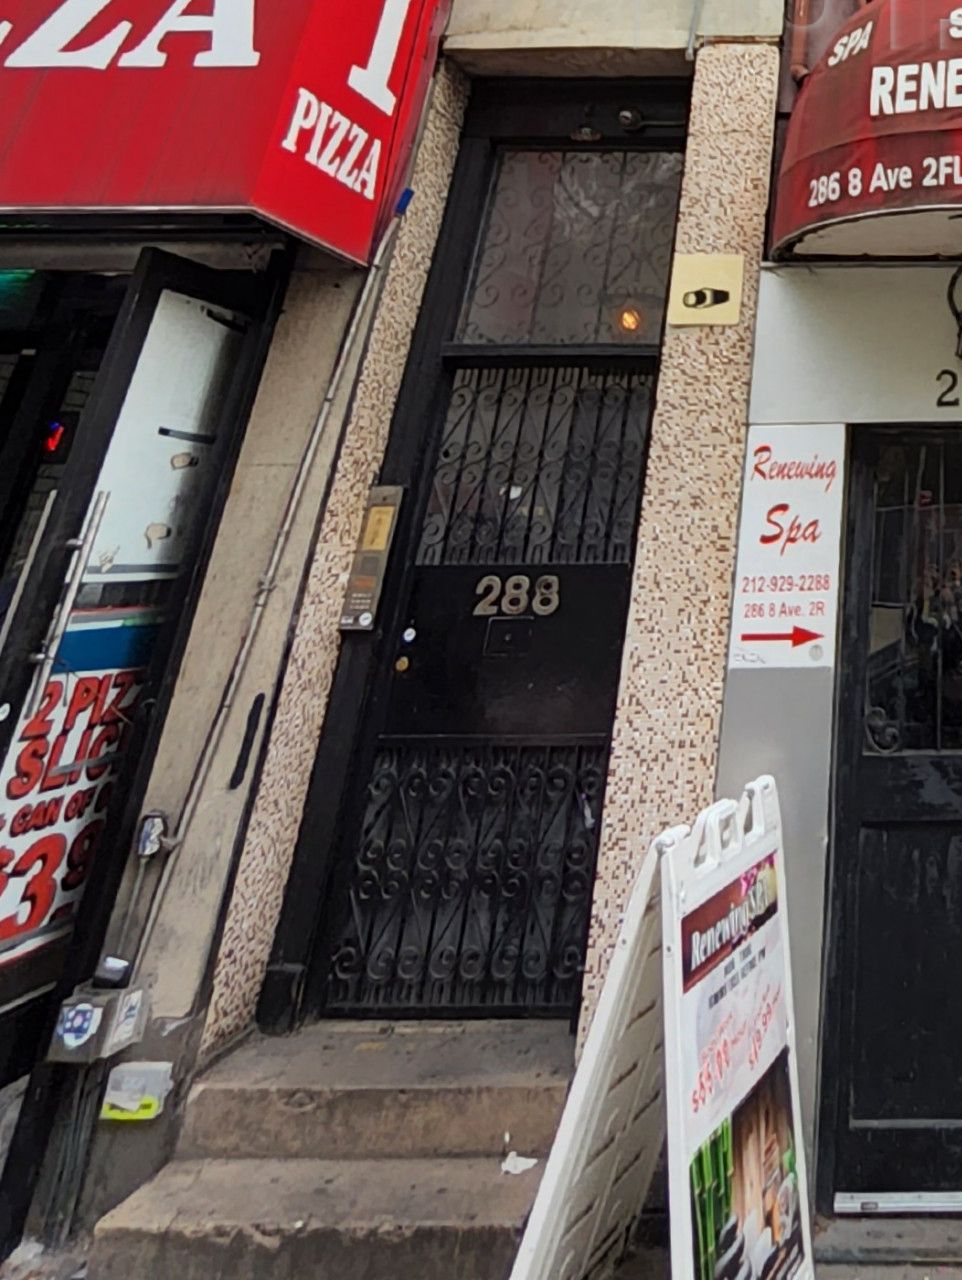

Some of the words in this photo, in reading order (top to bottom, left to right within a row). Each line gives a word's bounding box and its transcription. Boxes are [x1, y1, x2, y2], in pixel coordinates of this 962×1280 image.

[827, 20, 874, 67] SPA
[281, 87, 382, 200] PIZZA
[807, 171, 841, 208] 286
[847, 167, 862, 197] 8
[869, 162, 912, 193] Ave
[750, 444, 837, 492] Renewing
[760, 503, 823, 556] Spa
[473, 574, 560, 616] 288
[744, 603, 765, 618] 286
[768, 602, 776, 618] 8
[809, 601, 825, 616] 2R
[19, 680, 63, 742] 2
[6, 721, 128, 800] SLIC
[10, 794, 64, 838] CAN
[690, 901, 750, 972] Renewing
